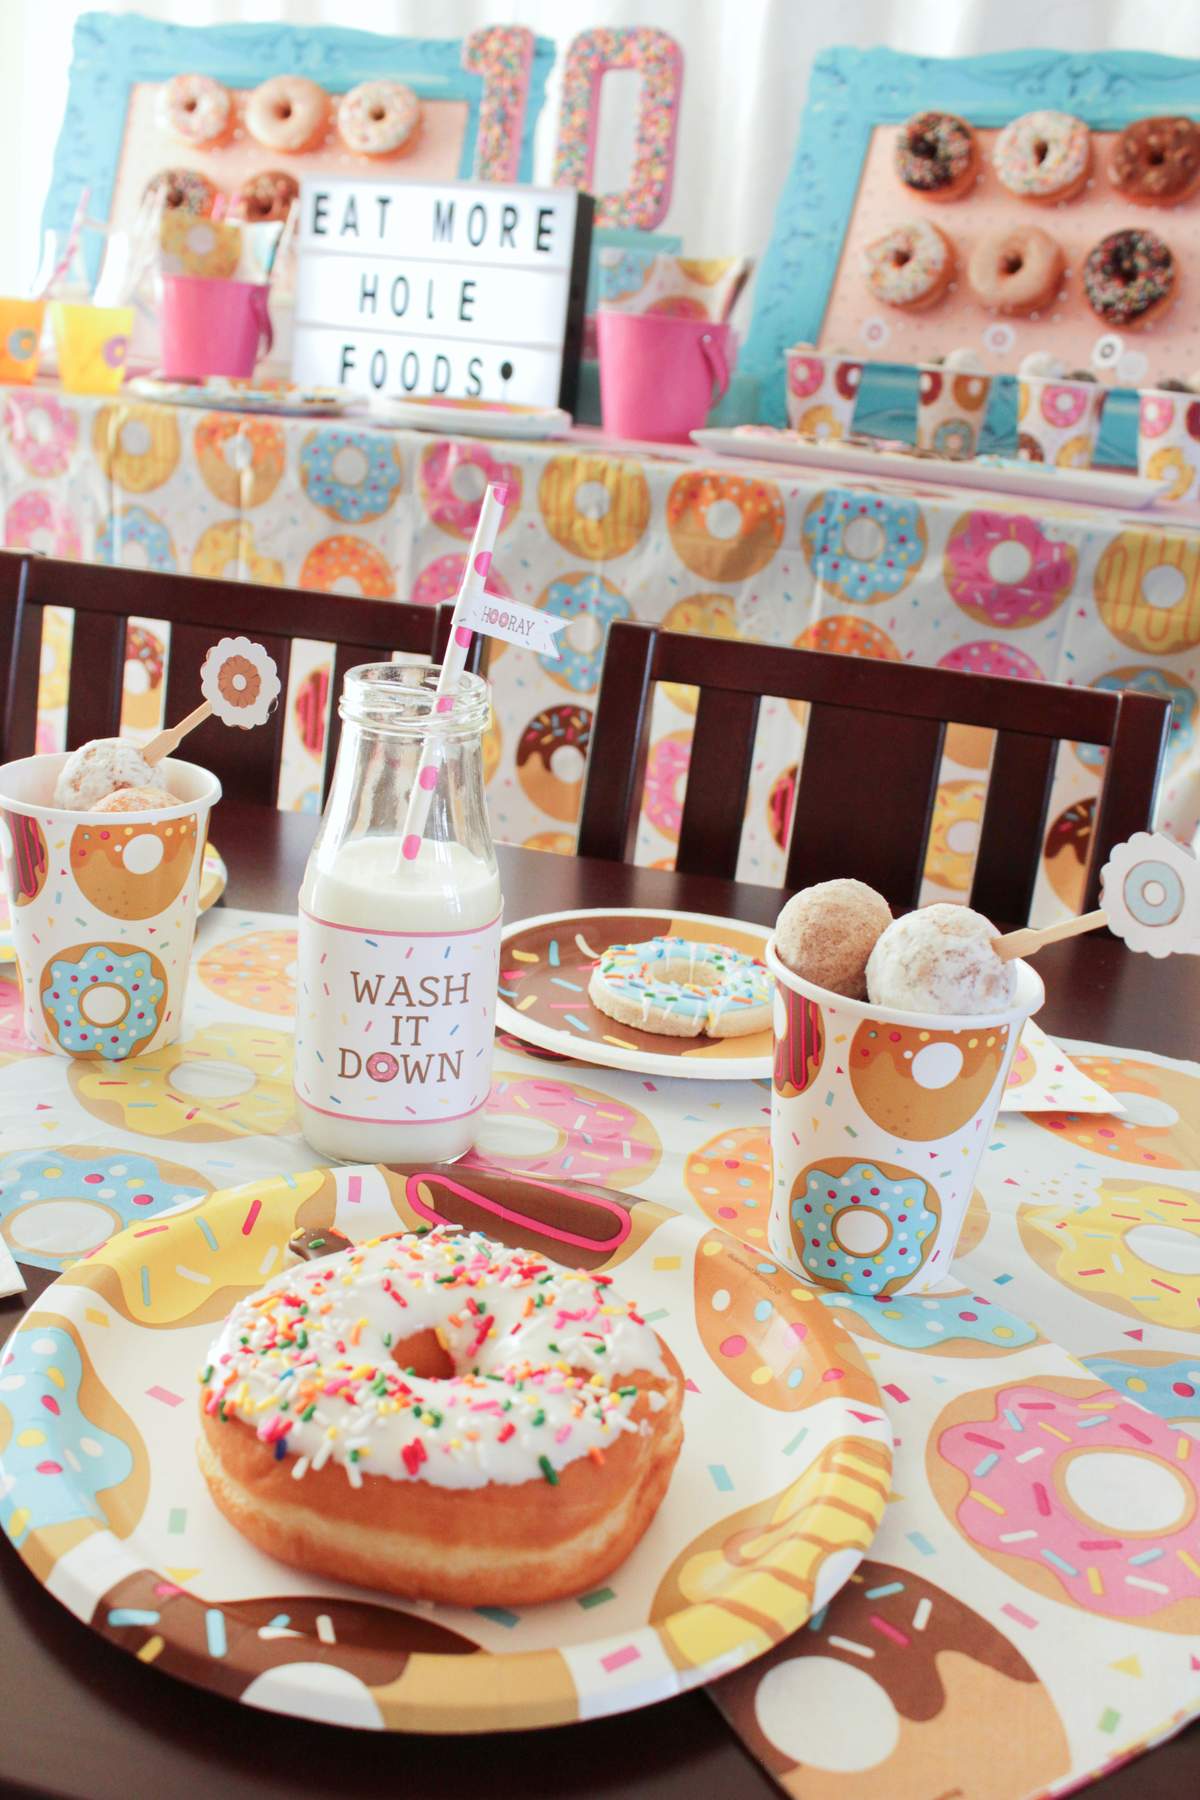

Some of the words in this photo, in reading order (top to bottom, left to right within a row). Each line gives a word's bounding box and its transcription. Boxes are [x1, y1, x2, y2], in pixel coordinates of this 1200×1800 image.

[462, 25, 684, 231] 10
[312, 192, 391, 239] EAT
[432, 199, 555, 252] MORE
[358, 272, 476, 322] HOLE
[481, 605, 535, 636] HOORAY
[350, 970, 471, 1007] WASH
[390, 1015, 429, 1046] IT
[337, 1047, 464, 1084] DOWN
